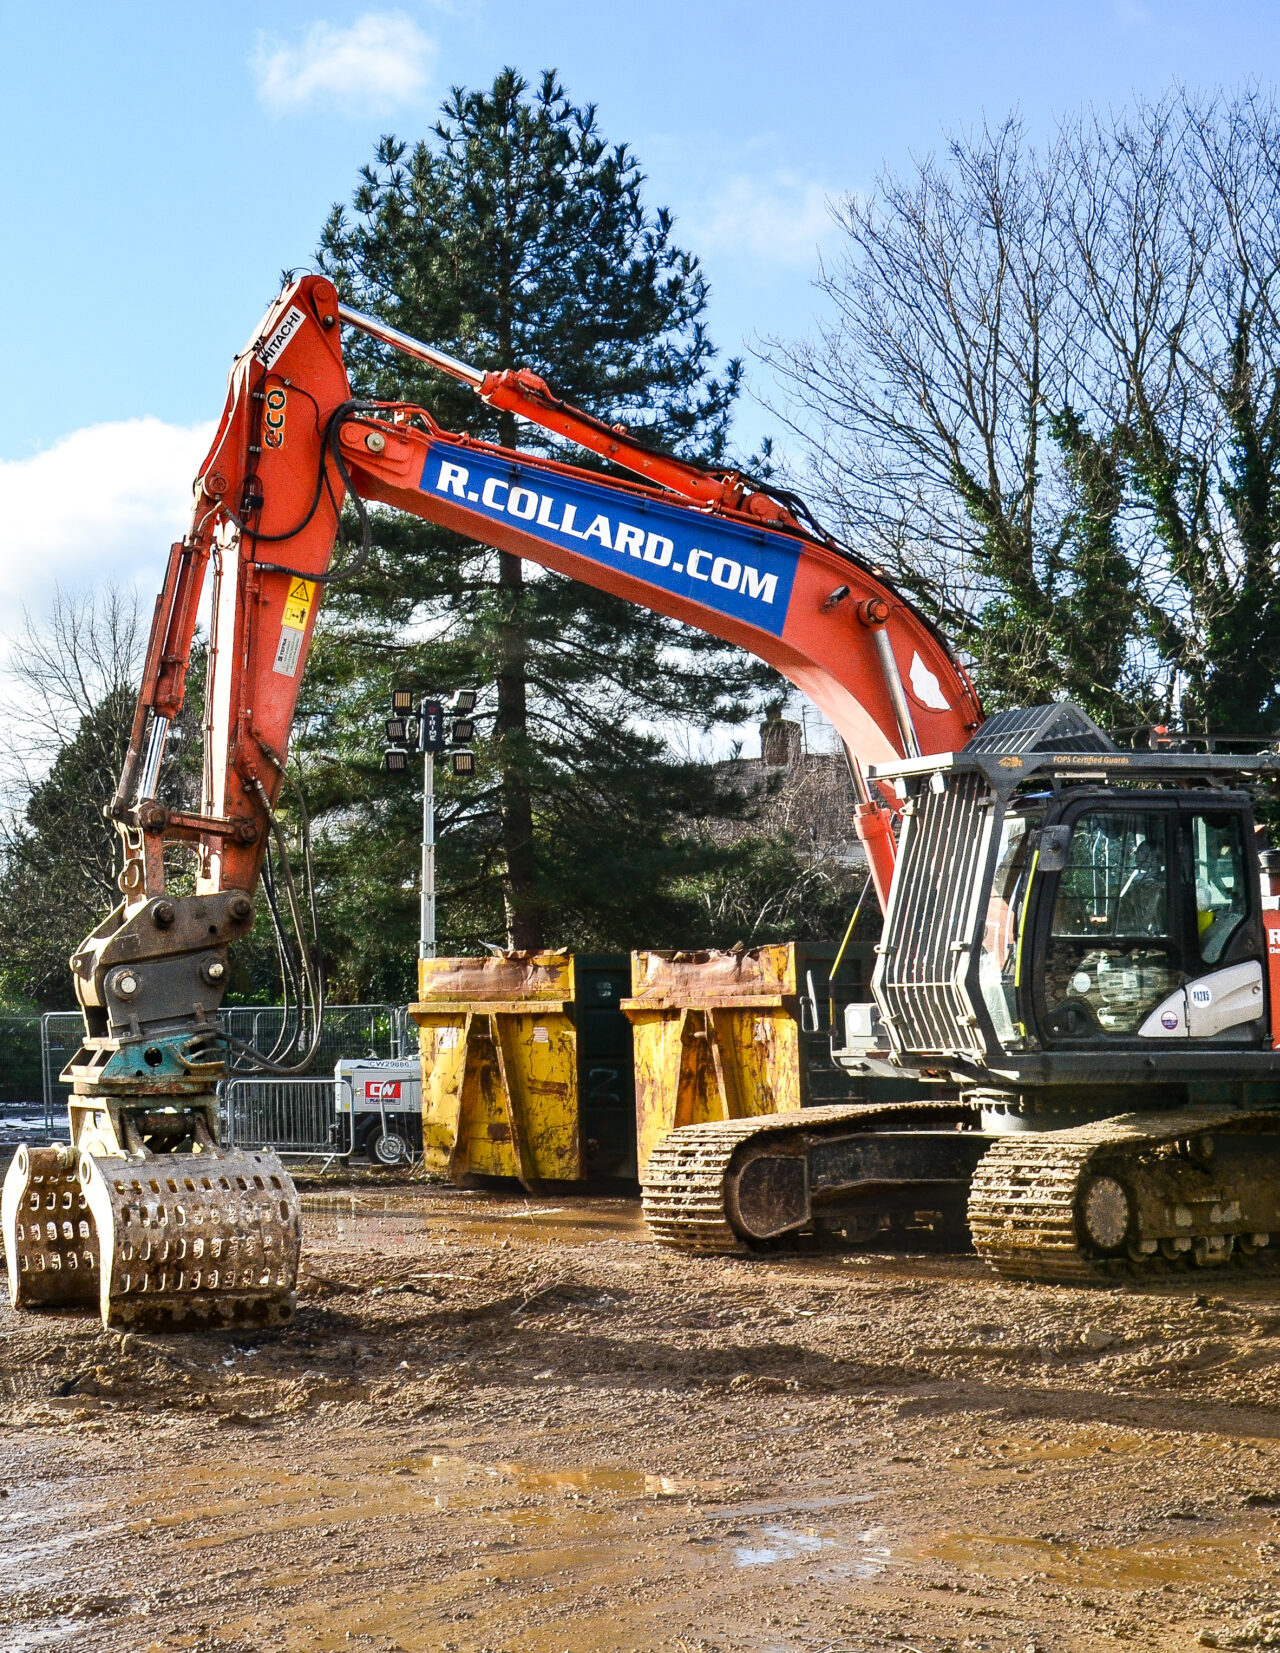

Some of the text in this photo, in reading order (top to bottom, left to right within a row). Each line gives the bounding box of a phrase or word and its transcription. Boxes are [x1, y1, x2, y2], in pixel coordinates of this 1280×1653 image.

[263, 311, 302, 365] HITACHI
[435, 460, 780, 604] R.COLLARD.COM
[1053, 756, 1129, 765] FOPS Certified Guards
